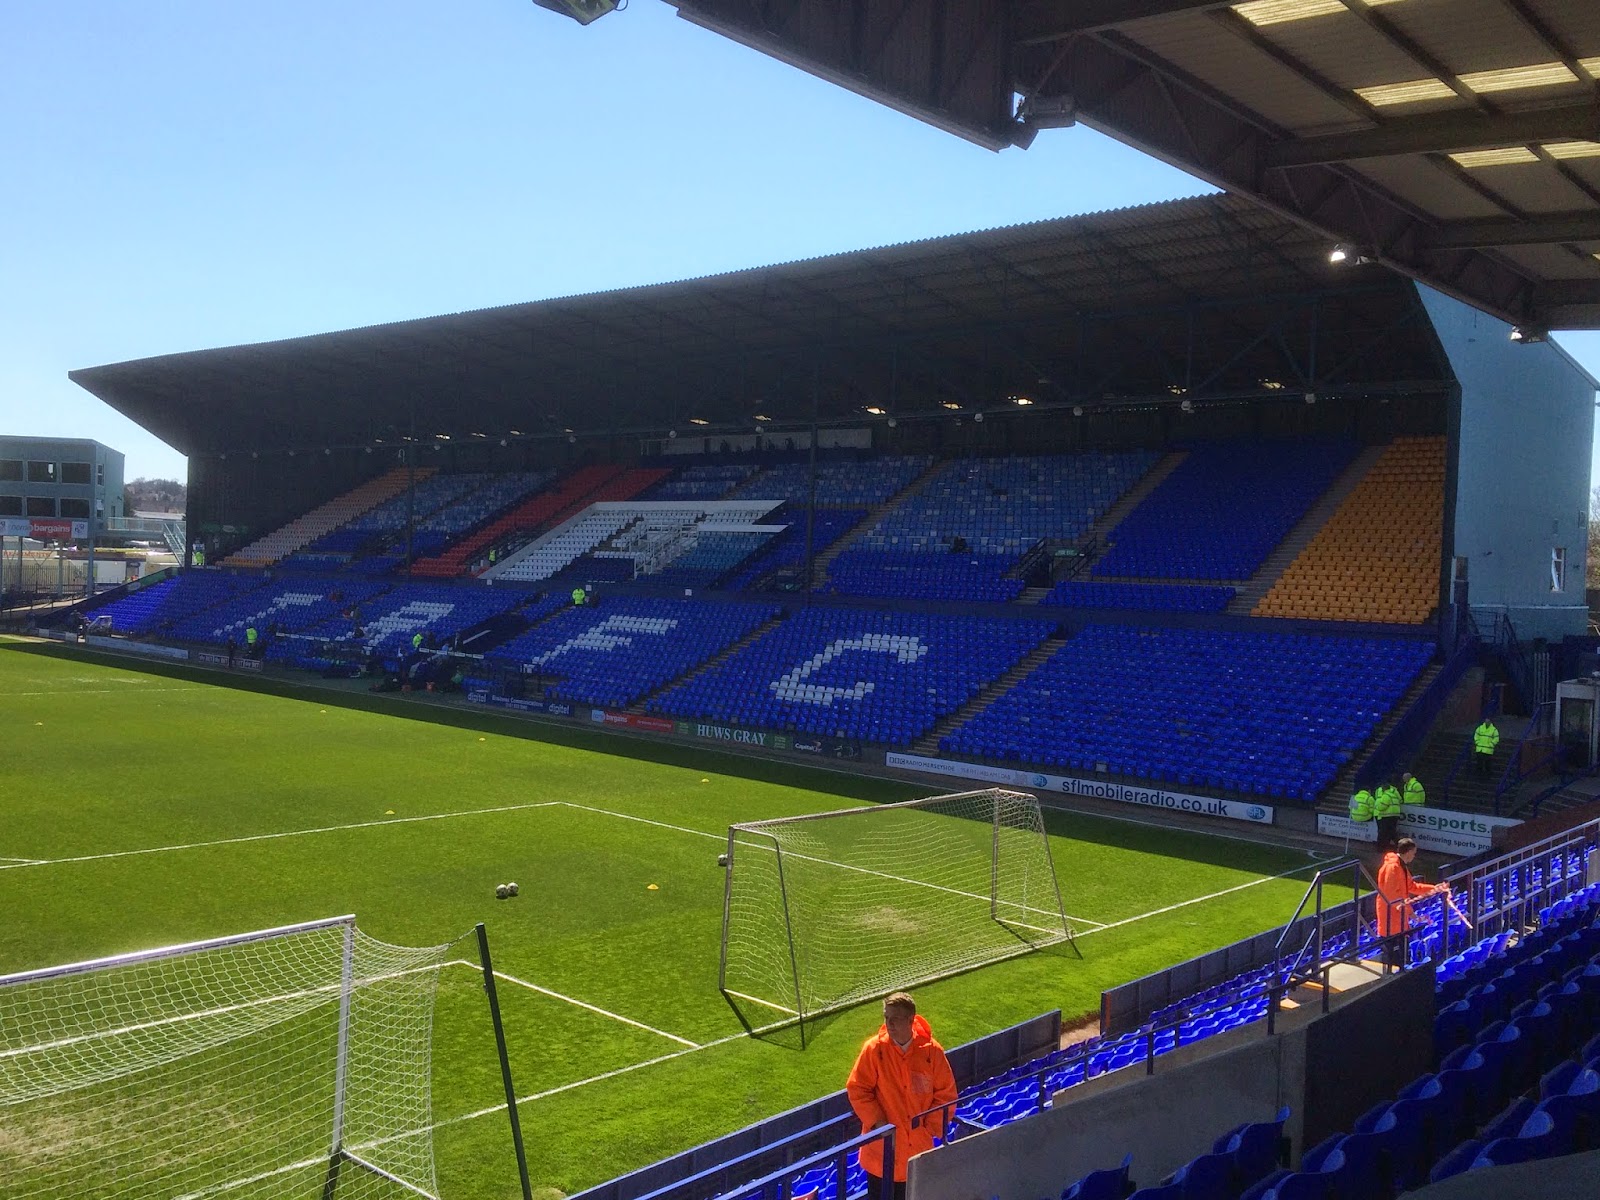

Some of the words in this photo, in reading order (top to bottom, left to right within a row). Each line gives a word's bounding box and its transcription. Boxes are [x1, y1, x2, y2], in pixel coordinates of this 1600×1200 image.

[34, 523, 70, 533] bargains
[522, 615, 678, 672] F
[769, 633, 928, 706] C
[548, 703, 570, 714] digitel
[697, 724, 731, 742] HUWS
[733, 729, 767, 746] GRAY
[906, 759, 923, 767] RADIO
[923, 762, 955, 772] MERSEYSIDE
[1061, 779, 1228, 816] sflmobileradio.co.uk
[1247, 807, 1266, 819] SFL
[1418, 833, 1452, 846] delivering
[1454, 839, 1477, 849] sports
[1477, 842, 1491, 851] pro
